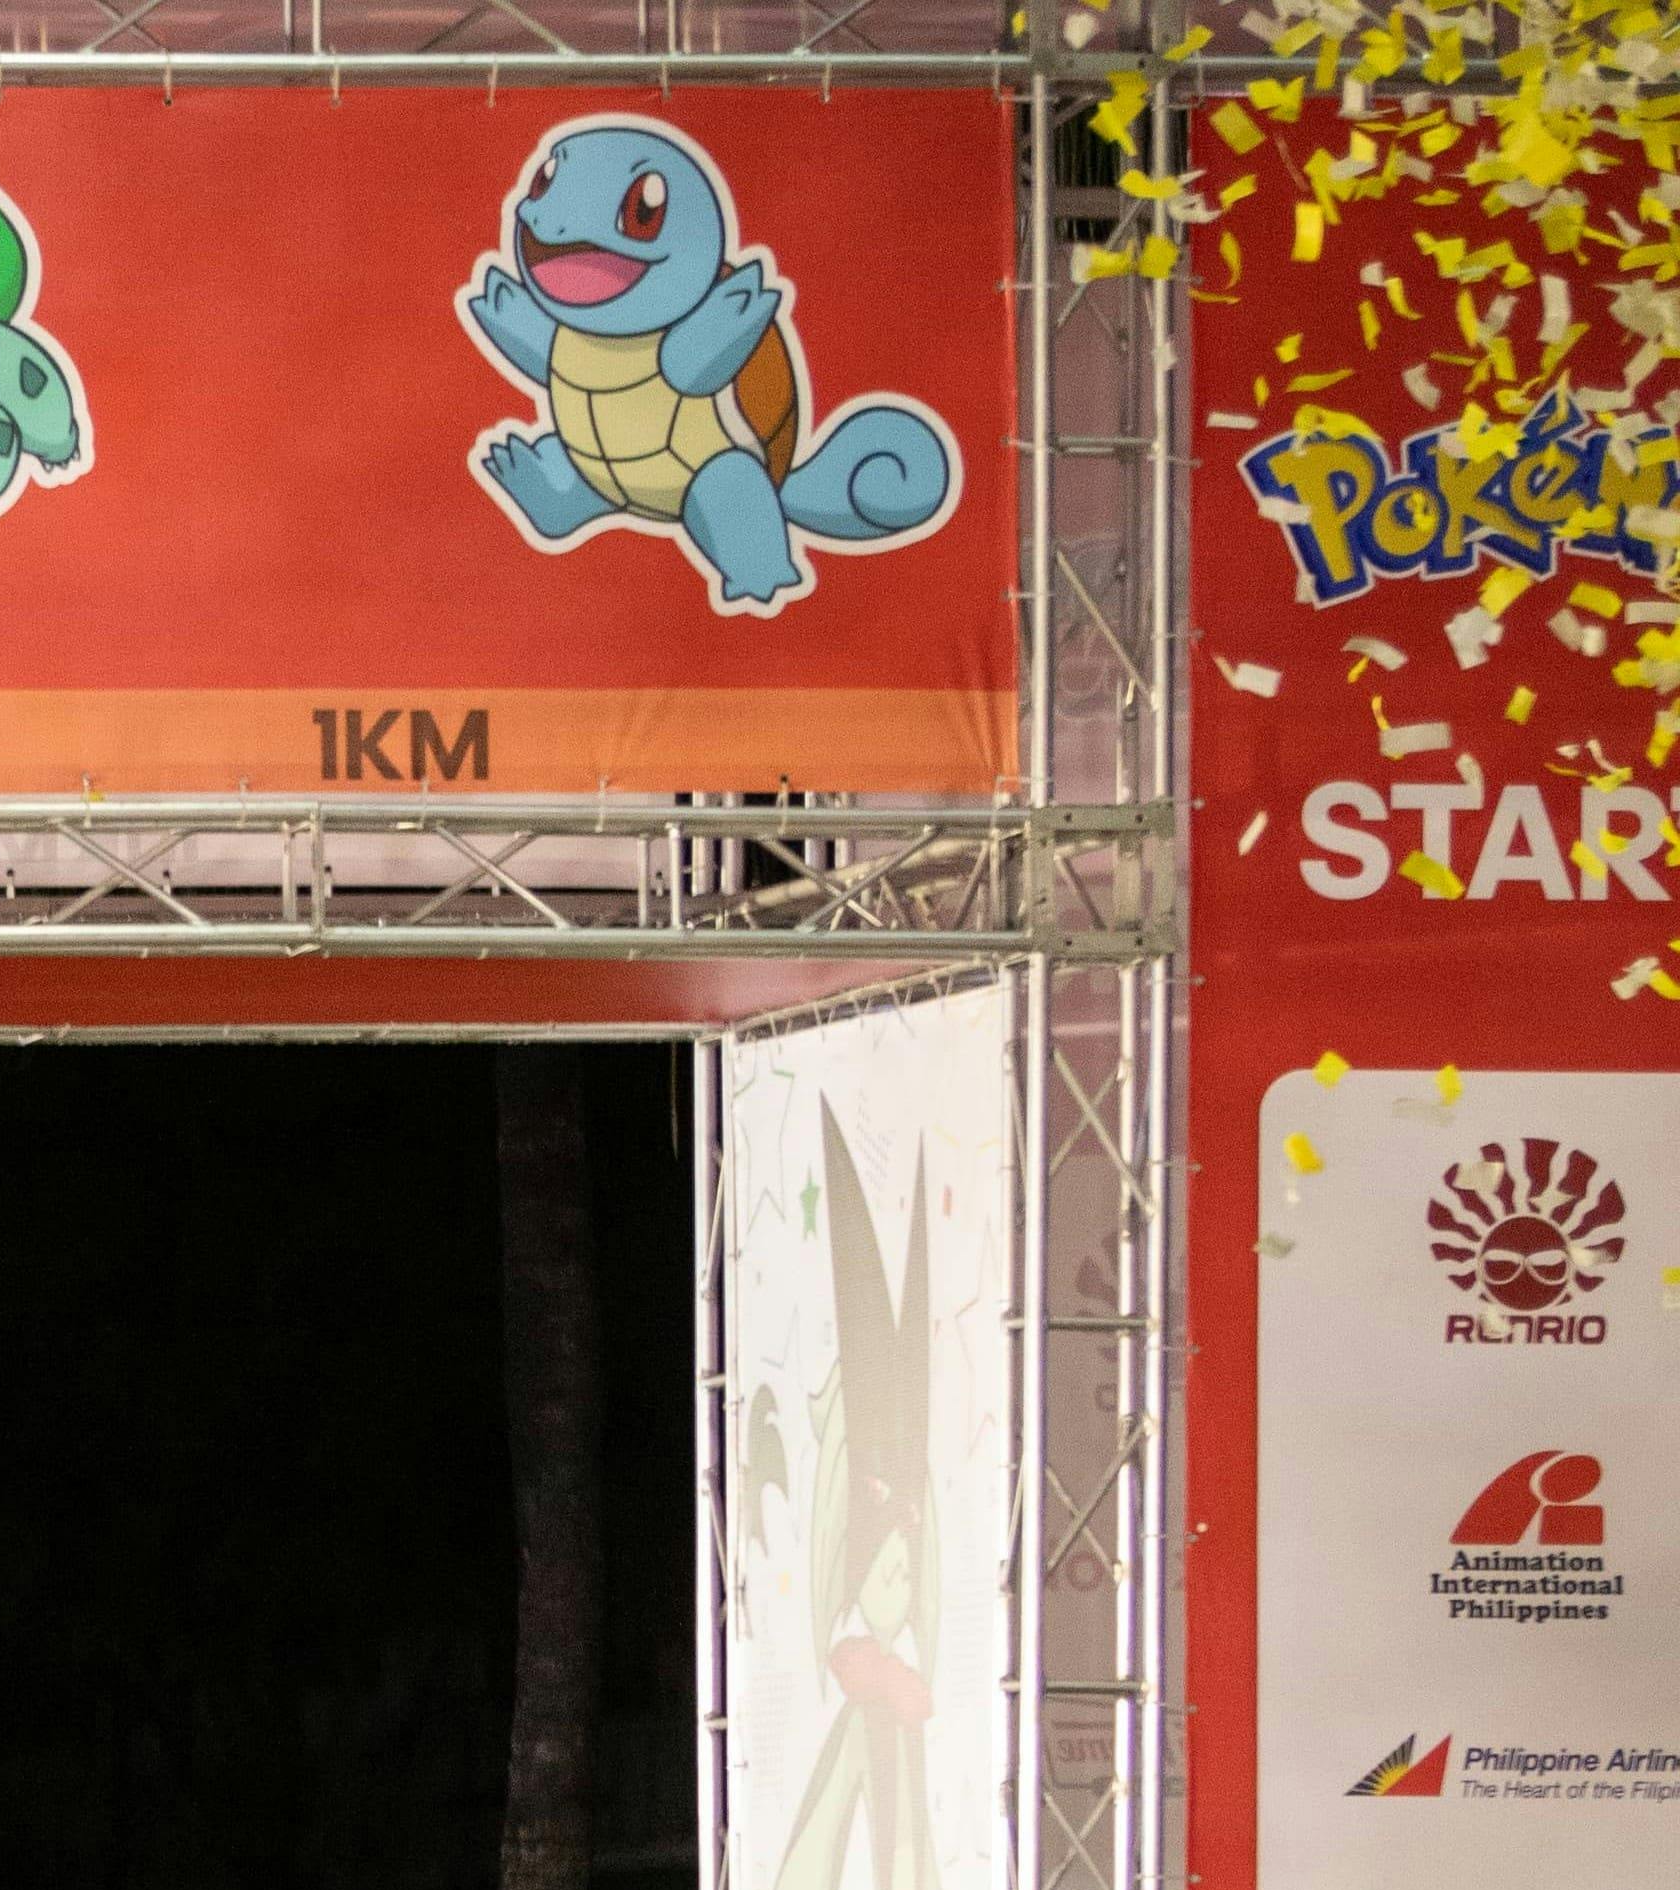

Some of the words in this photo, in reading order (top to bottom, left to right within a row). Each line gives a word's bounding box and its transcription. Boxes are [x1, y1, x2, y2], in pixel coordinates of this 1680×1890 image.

[312, 708, 491, 782] 1KM
[1298, 780, 1680, 901] STAR
[1450, 1550, 1605, 1572] Animation
[1430, 1573, 1624, 1596] International
[1448, 1598, 1610, 1622] Philippines
[1463, 1747, 1601, 1777] Philippine
[1461, 1779, 1498, 1799] The
[1503, 1779, 1561, 1799] Heart
[1566, 1780, 1590, 1799] of
[1593, 1780, 1625, 1799] the
